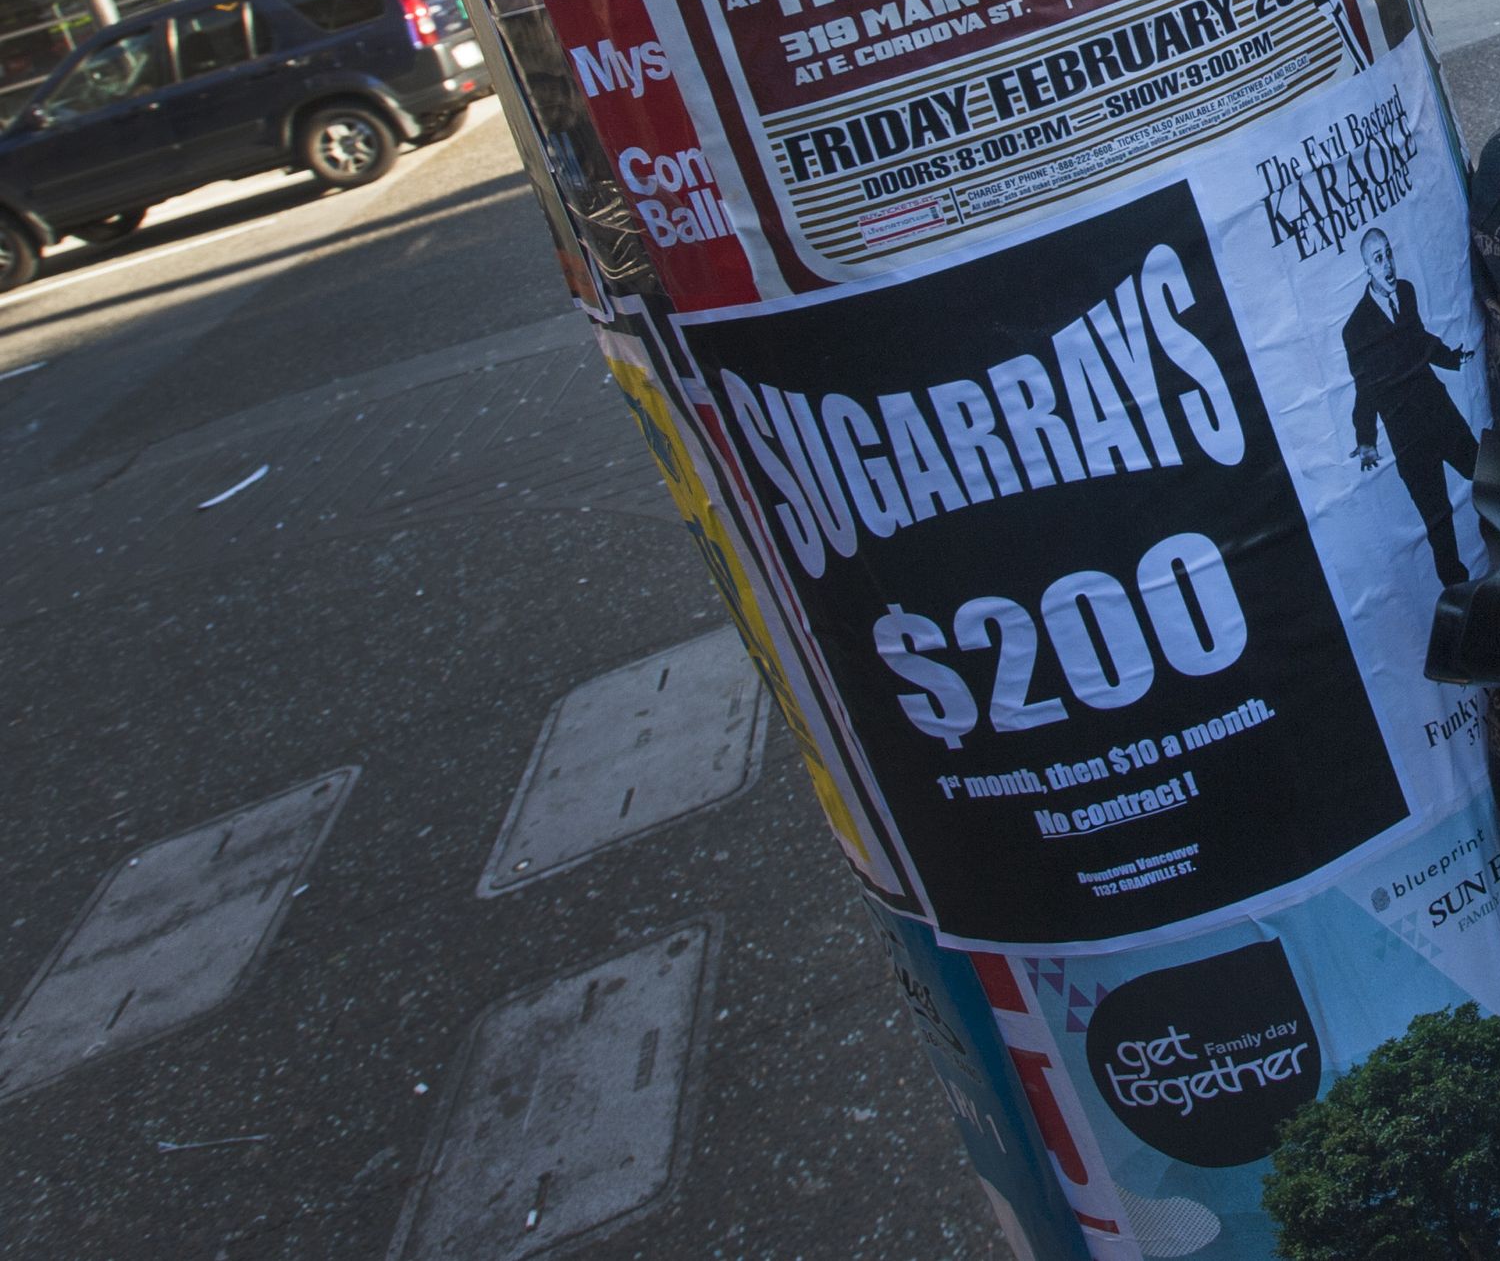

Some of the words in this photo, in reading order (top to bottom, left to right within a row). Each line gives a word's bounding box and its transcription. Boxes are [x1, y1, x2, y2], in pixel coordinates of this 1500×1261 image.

[779, 15, 860, 63] 319
[794, 61, 824, 86] AT
[827, 53, 855, 76] E.
[853, 12, 988, 67] CORDOVA
[782, 84, 972, 183] FRIDAY
[861, 154, 952, 201] DOORS
[1105, 72, 1180, 119] SHOW
[967, 181, 1002, 201] CHARGE
[1005, 176, 1017, 189] BY
[1018, 167, 1049, 187] PHONE
[1117, 127, 1151, 148] TICKETS
[1151, 119, 1173, 135] ALSO
[1175, 102, 1217, 126] AVAILABLE
[1273, 69, 1285, 83] AND
[1285, 61, 1297, 75] RED
[1019, 187, 1032, 197] and
[1104, 152, 1127, 167] change
[1200, 113, 1221, 129] charge
[1256, 154, 1303, 196] The
[1300, 122, 1348, 172] Evil
[1343, 84, 1407, 150] Bastard
[1262, 113, 1419, 248] KARAOKE
[1290, 163, 1414, 262] Experience
[720, 243, 1246, 579] SUGARRAYS
[872, 532, 1249, 751] $200
[964, 767, 1048, 799] month,
[1045, 756, 1110, 790] then
[1107, 737, 1160, 776] $10
[1161, 735, 1182, 758] a
[1181, 698, 1277, 752] month.
[1423, 694, 1480, 748] Funky
[1033, 809, 1071, 836] No
[1072, 775, 1187, 831] contract
[1076, 861, 1138, 884] Downtown
[1135, 842, 1200, 871] Vancouver
[1118, 865, 1179, 892] GRANVILLE
[1392, 828, 1486, 899] blueprint
[1428, 871, 1488, 929] SUN
[1104, 1042, 1309, 1118] together
[1116, 1025, 1199, 1080] get
[1203, 1033, 1262, 1058] Family
[1264, 1020, 1298, 1042] day
